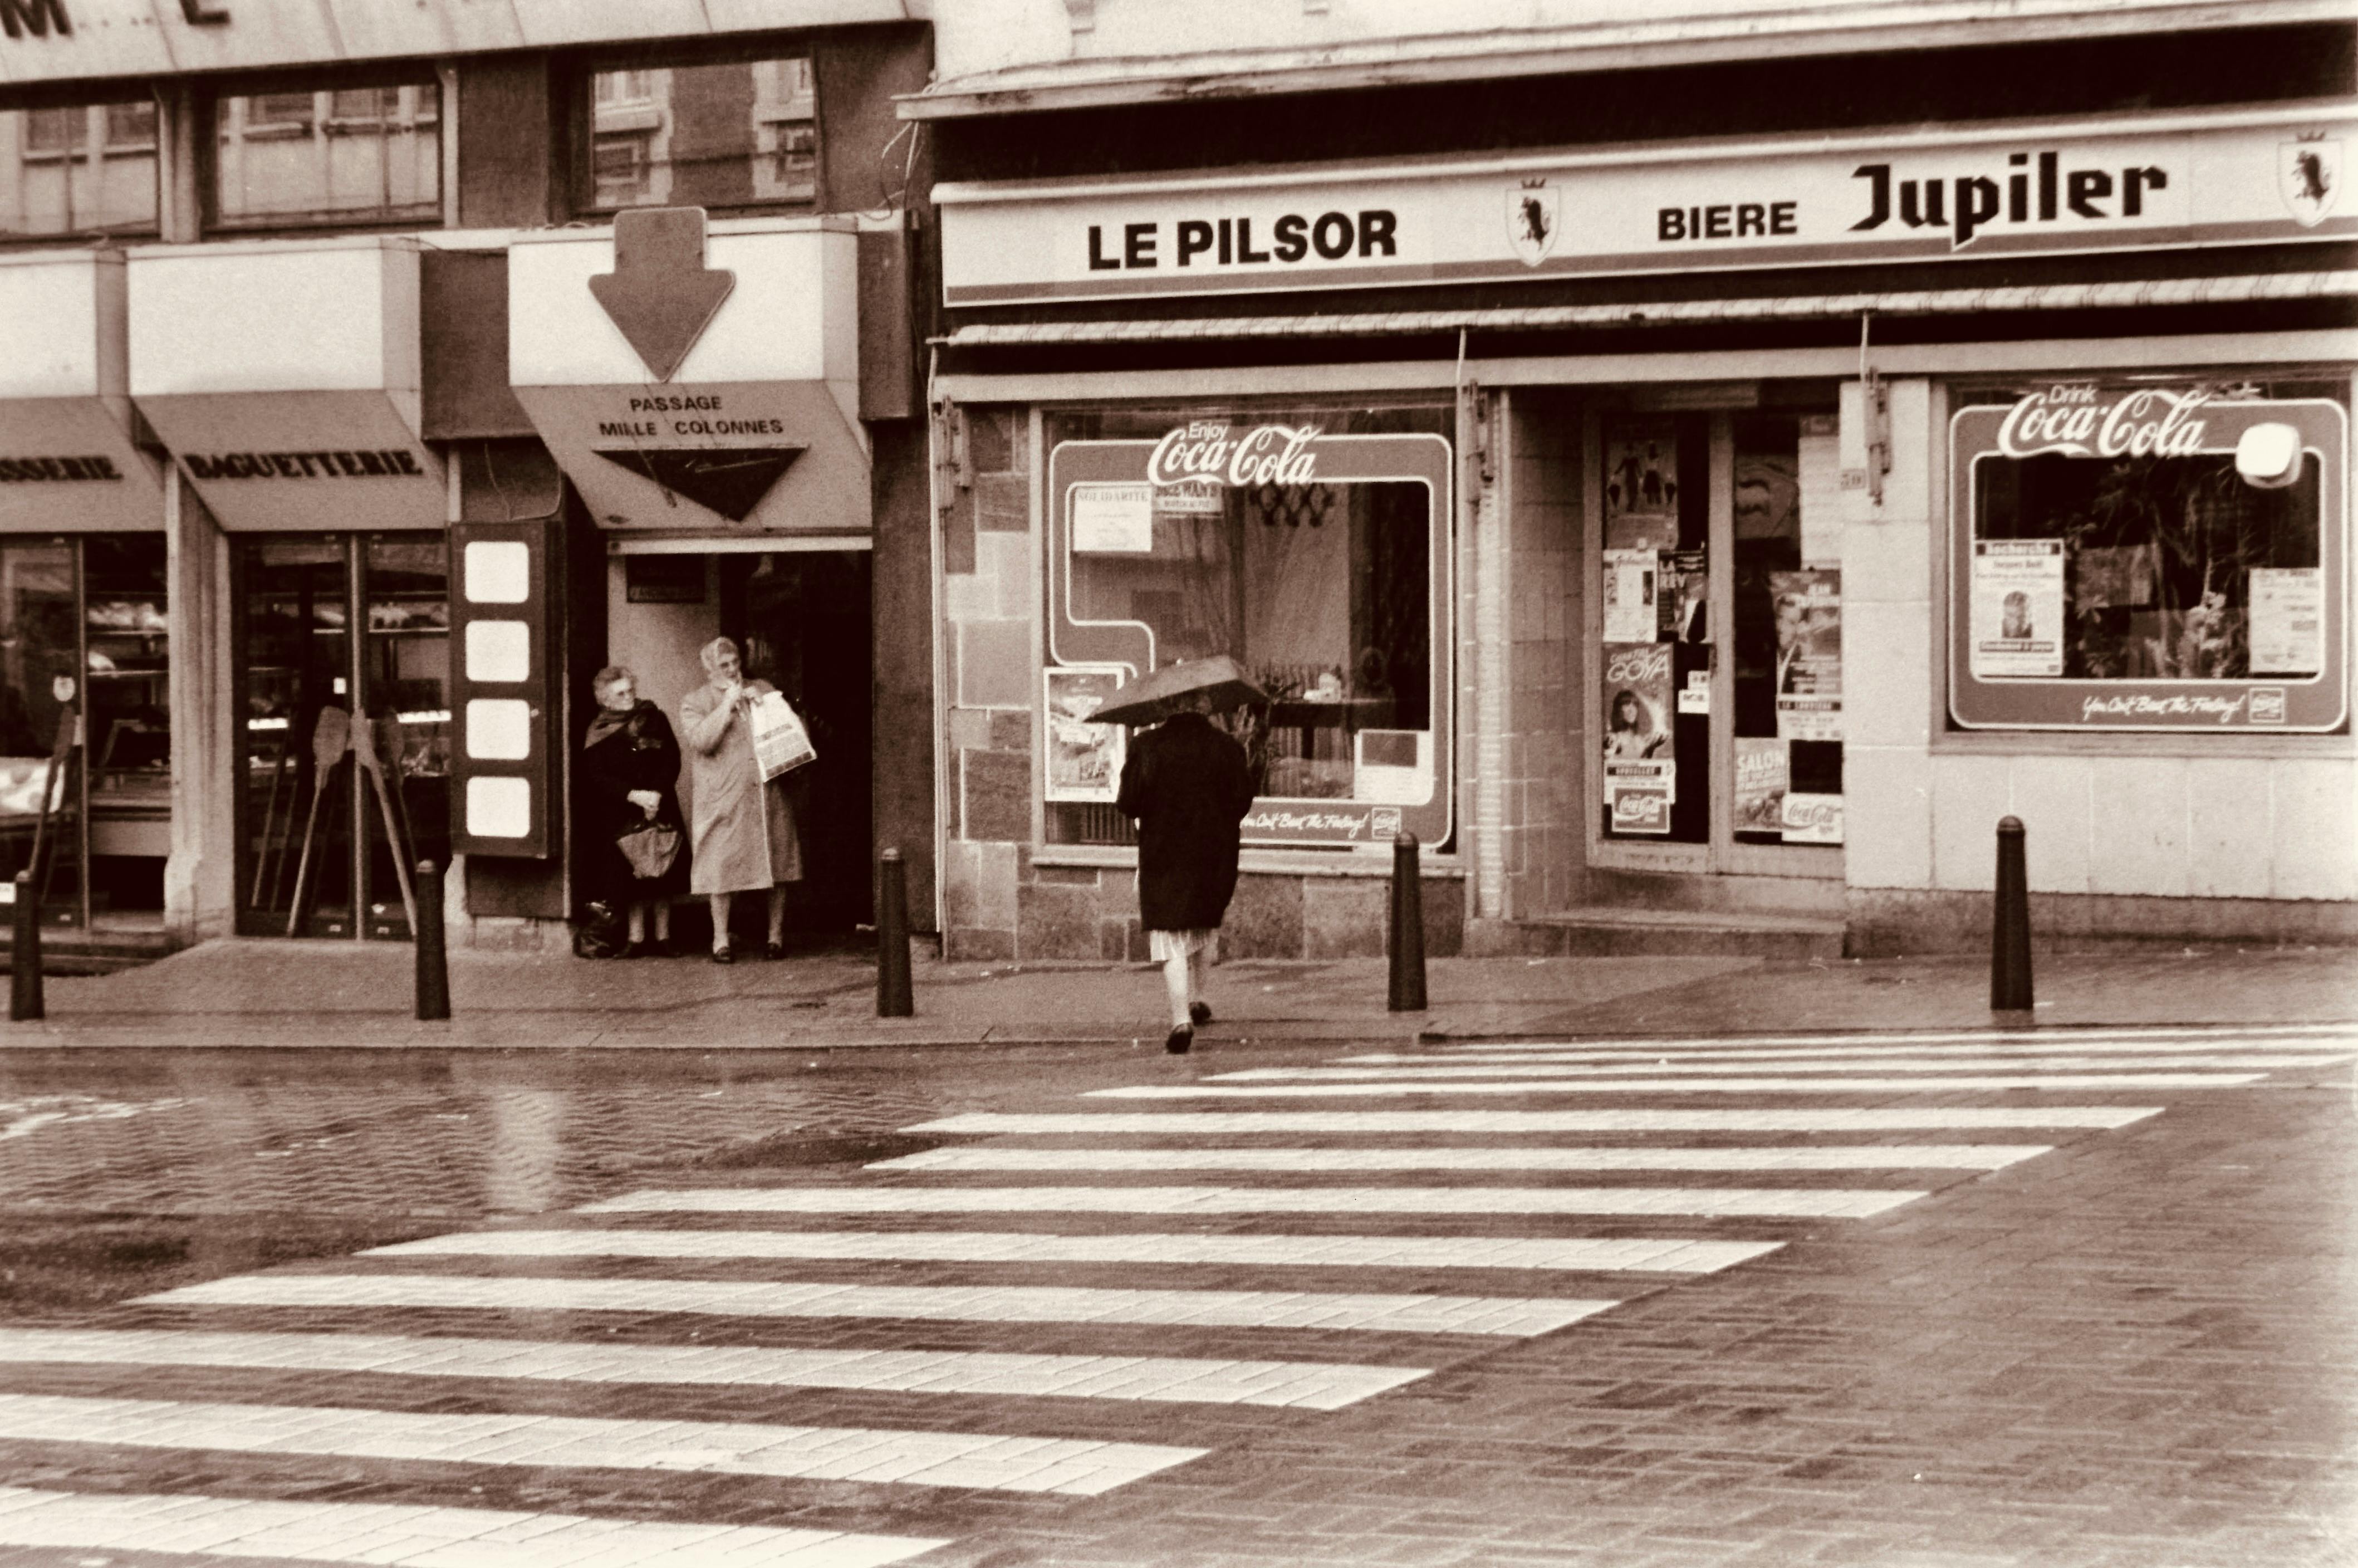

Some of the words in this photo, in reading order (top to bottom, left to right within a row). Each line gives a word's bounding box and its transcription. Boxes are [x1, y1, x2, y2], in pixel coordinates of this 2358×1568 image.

[1658, 202, 1798, 242] BIERE
[1848, 151, 2168, 246] Jupiler
[1089, 223, 1158, 271] LE
[1176, 209, 1398, 267] PILSOR
[630, 395, 723, 413] PASSAGE
[2049, 384, 2097, 404] Drink
[599, 422, 657, 437] MILLE
[674, 419, 784, 436] COLONNES
[1187, 421, 1228, 442] Enjoy
[183, 450, 424, 479] BAGUETTERIE
[1607, 646, 1670, 683] GOYA
